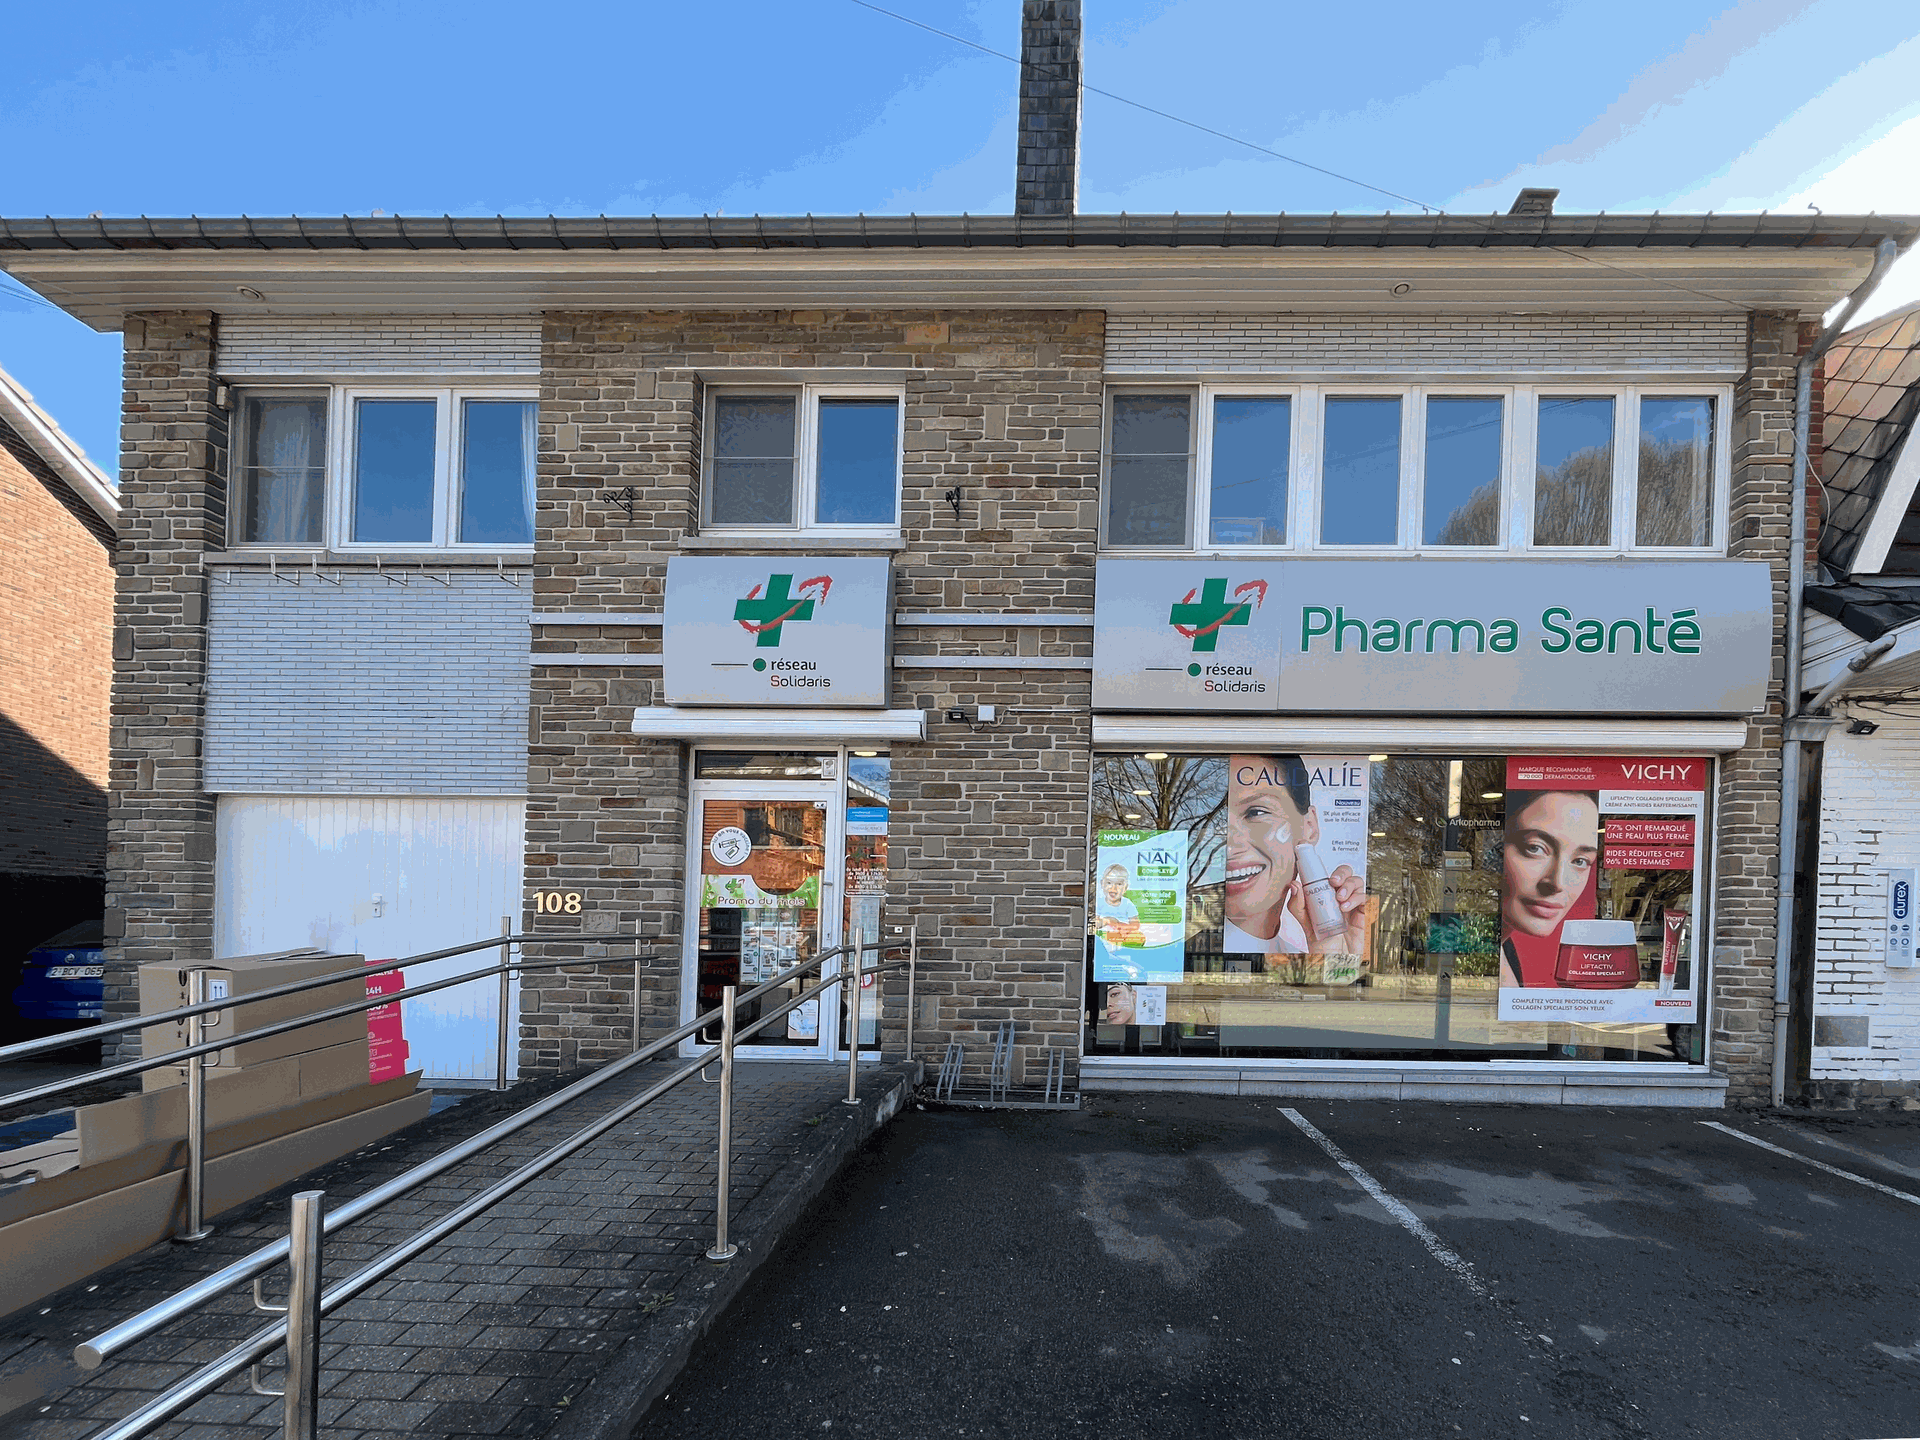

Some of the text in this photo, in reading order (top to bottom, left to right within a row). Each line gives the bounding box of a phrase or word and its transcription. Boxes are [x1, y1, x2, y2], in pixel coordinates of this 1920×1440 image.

[1301, 606, 1702, 654] Pharma Santé
[771, 658, 816, 671] réseau
[1205, 663, 1252, 676] réseau
[770, 675, 831, 687] Solidaris
[1204, 680, 1266, 693] Solidaris
[1621, 764, 1692, 780] VICHY
[1449, 818, 1501, 827] Arkopharma
[1644, 824, 1686, 832] REMARQUÉ
[1137, 852, 1178, 864] NAN
[1628, 849, 1662, 857] RÉDUITES
[532, 892, 581, 913] 108
[718, 896, 806, 906] Promo du mois
[1894, 882, 1908, 917] durex
